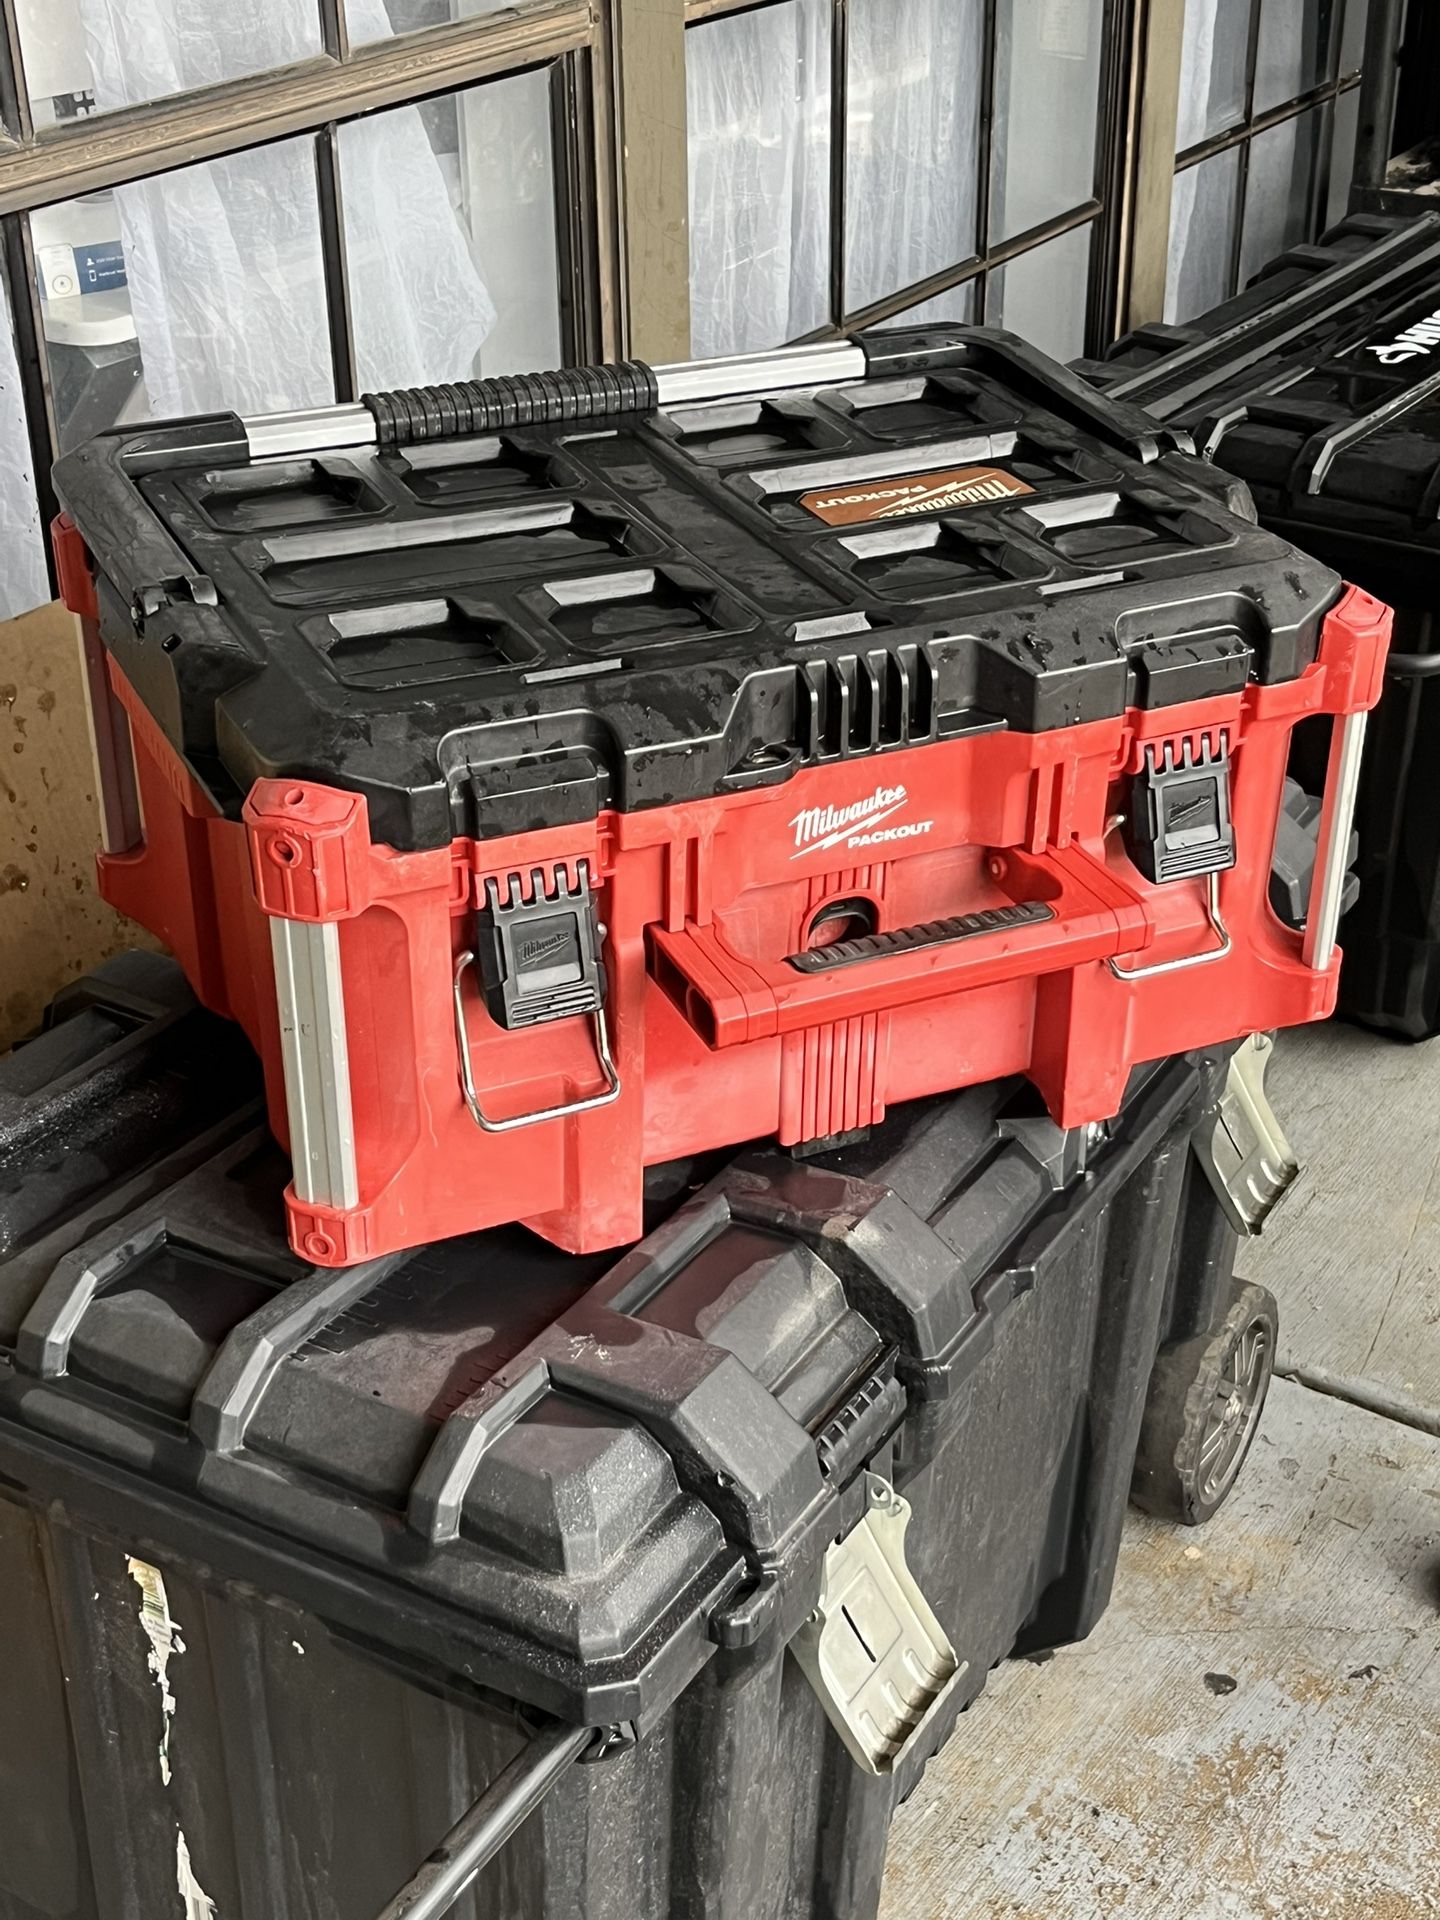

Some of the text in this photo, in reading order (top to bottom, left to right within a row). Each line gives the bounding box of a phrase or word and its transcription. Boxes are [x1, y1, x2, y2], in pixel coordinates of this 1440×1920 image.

[815, 485, 928, 509] PACKOUT
[787, 784, 907, 847] Milwaukee
[847, 820, 934, 849] PACKOUT
